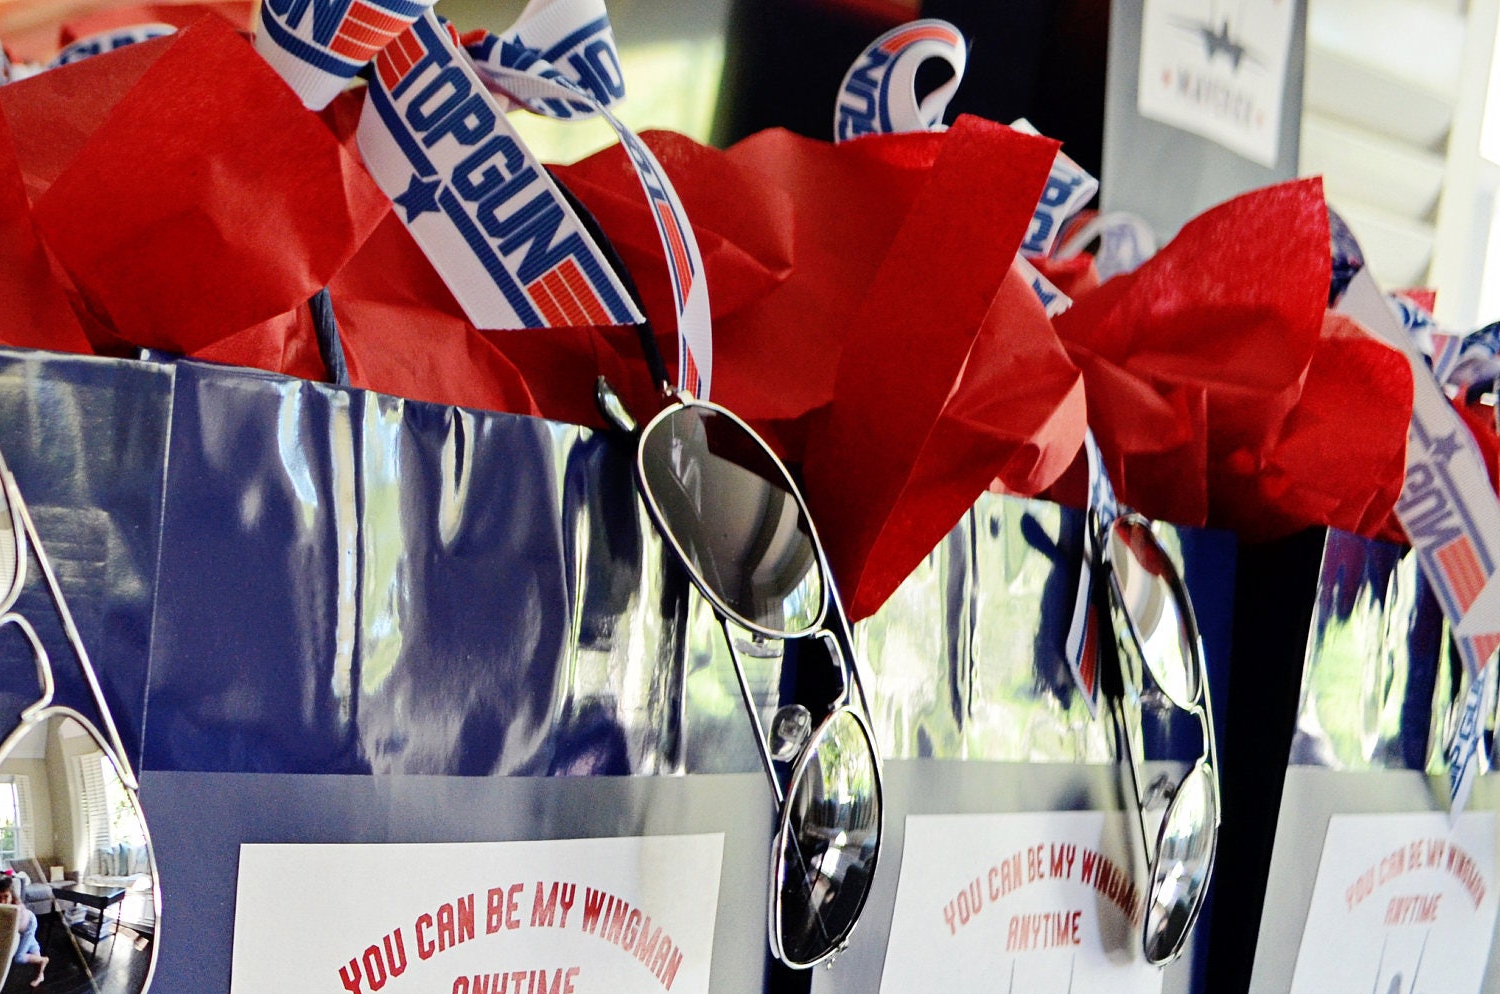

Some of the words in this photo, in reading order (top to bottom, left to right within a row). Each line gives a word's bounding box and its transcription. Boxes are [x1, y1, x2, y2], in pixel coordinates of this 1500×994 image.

[414, 892, 477, 962] CAN
[485, 882, 525, 936] BE
[529, 880, 577, 930] MY
[581, 885, 684, 991] WINGMAN
[942, 876, 983, 936] YOU
[988, 849, 1023, 903] CAN
[1027, 842, 1046, 880] BE
[1049, 842, 1077, 880] MY
[1006, 909, 1083, 953] ANYTIME
